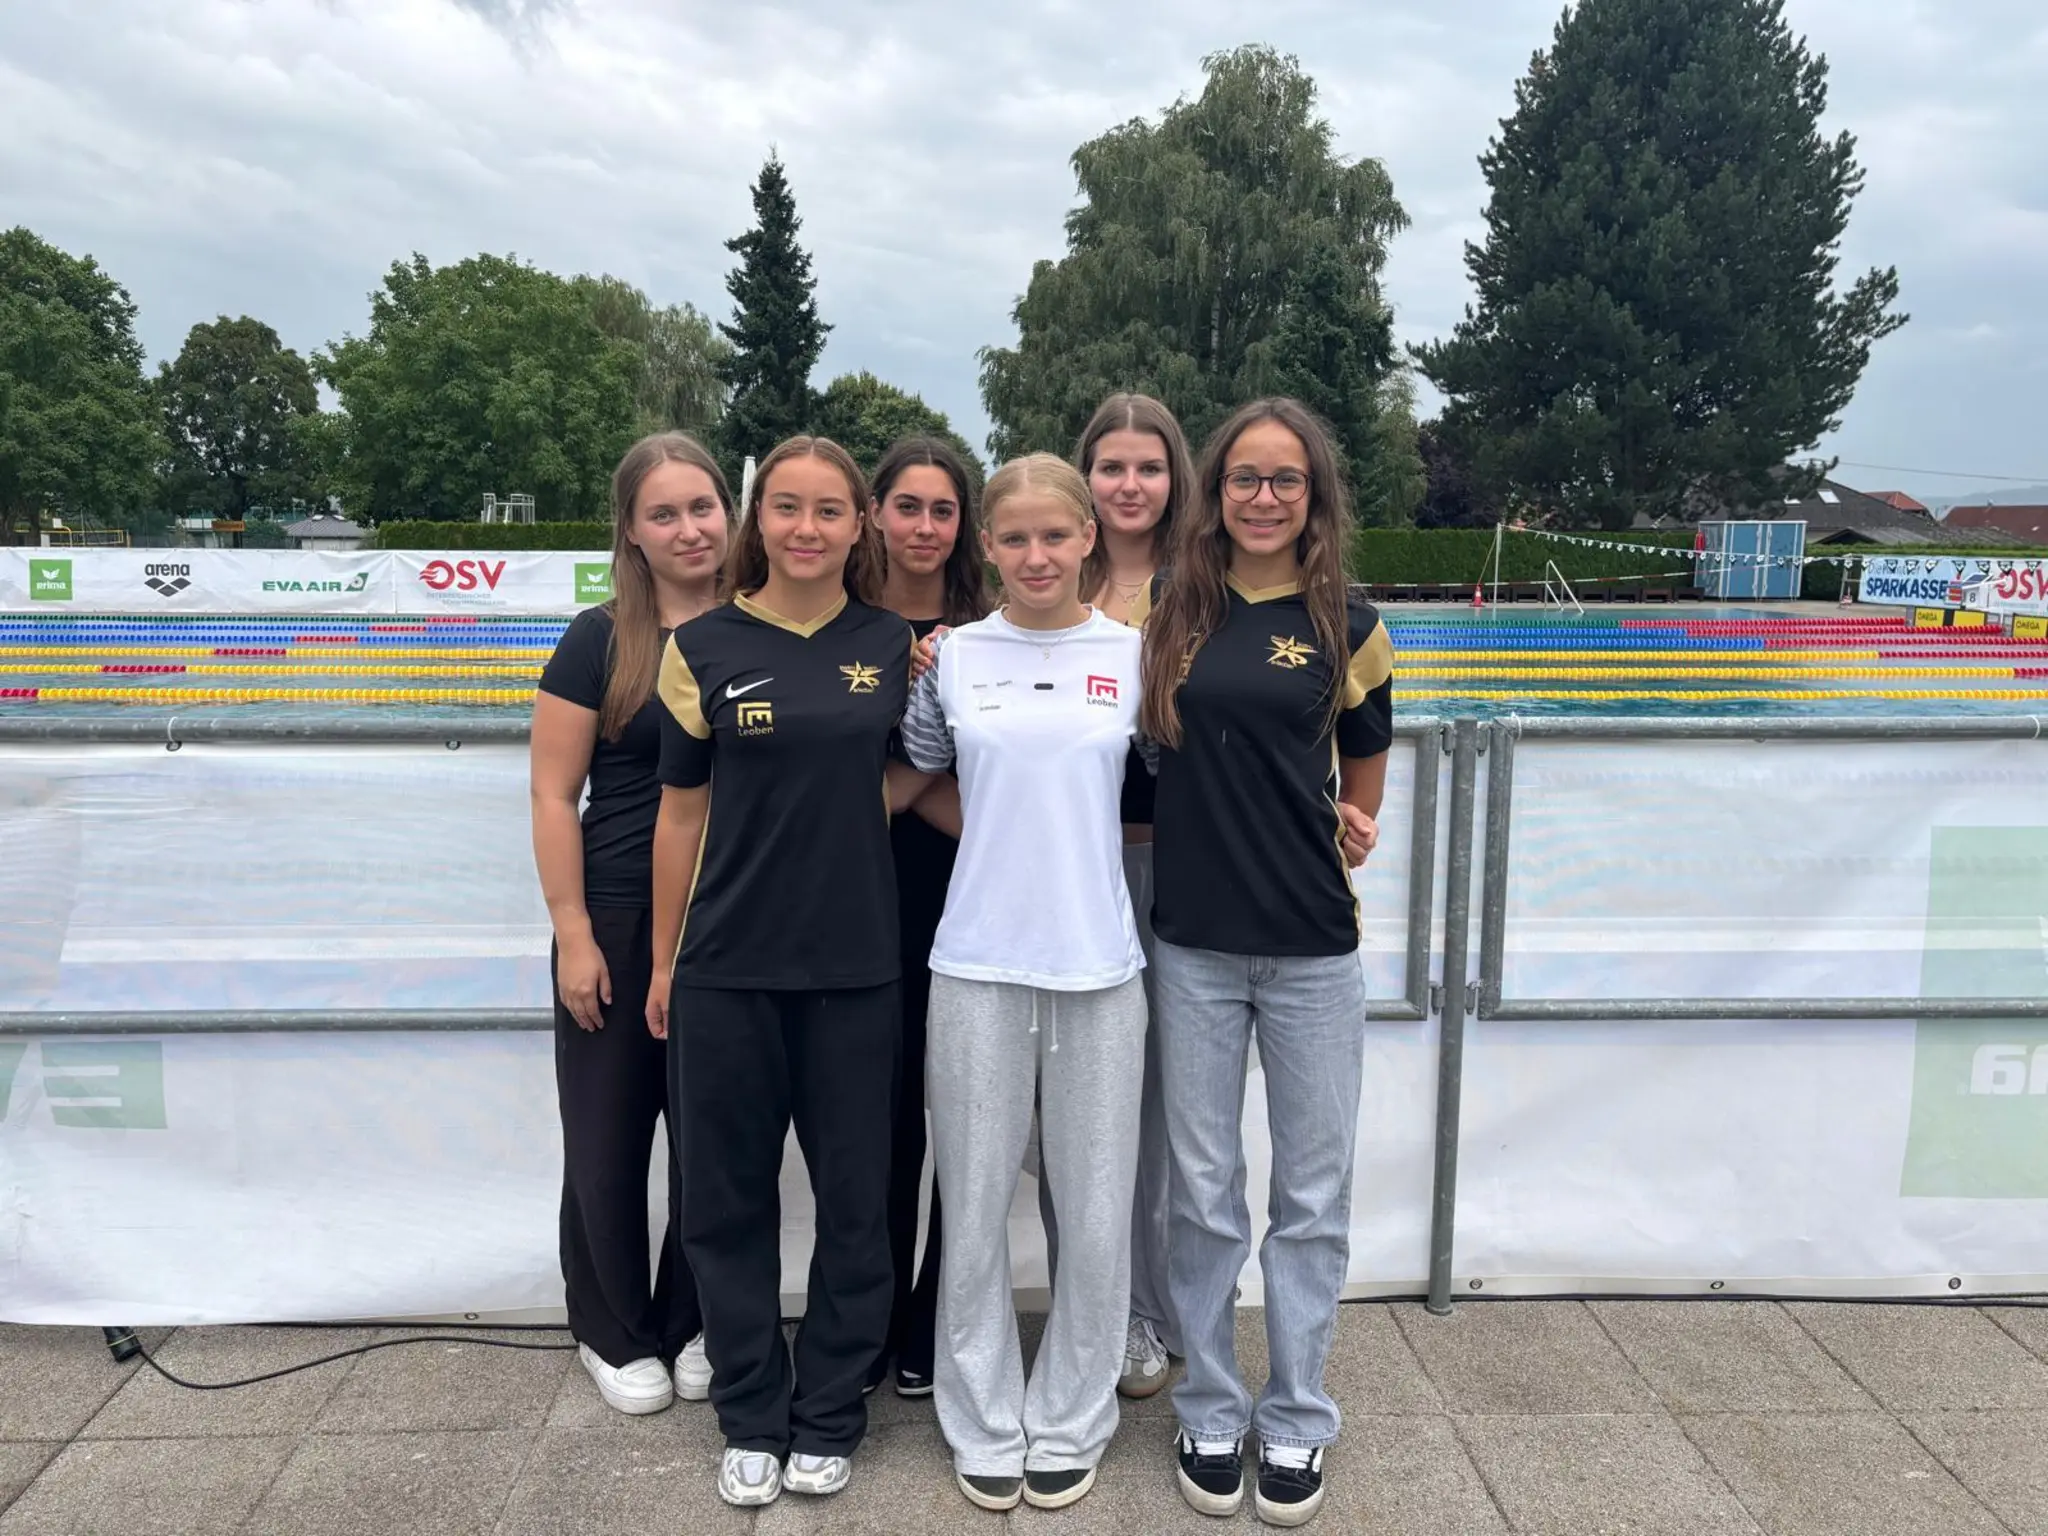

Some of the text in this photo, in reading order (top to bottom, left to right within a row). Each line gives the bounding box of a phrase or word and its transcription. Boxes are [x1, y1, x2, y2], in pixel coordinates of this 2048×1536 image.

[144, 563, 190, 576] arena
[36, 580, 66, 590] erima
[262, 581, 341, 592] EVA AIR
[1866, 577, 1948, 600] SPARKASSE
[1969, 593, 1976, 603] 8
[1087, 697, 1119, 709] Leoben
[738, 727, 774, 737] Leoben
